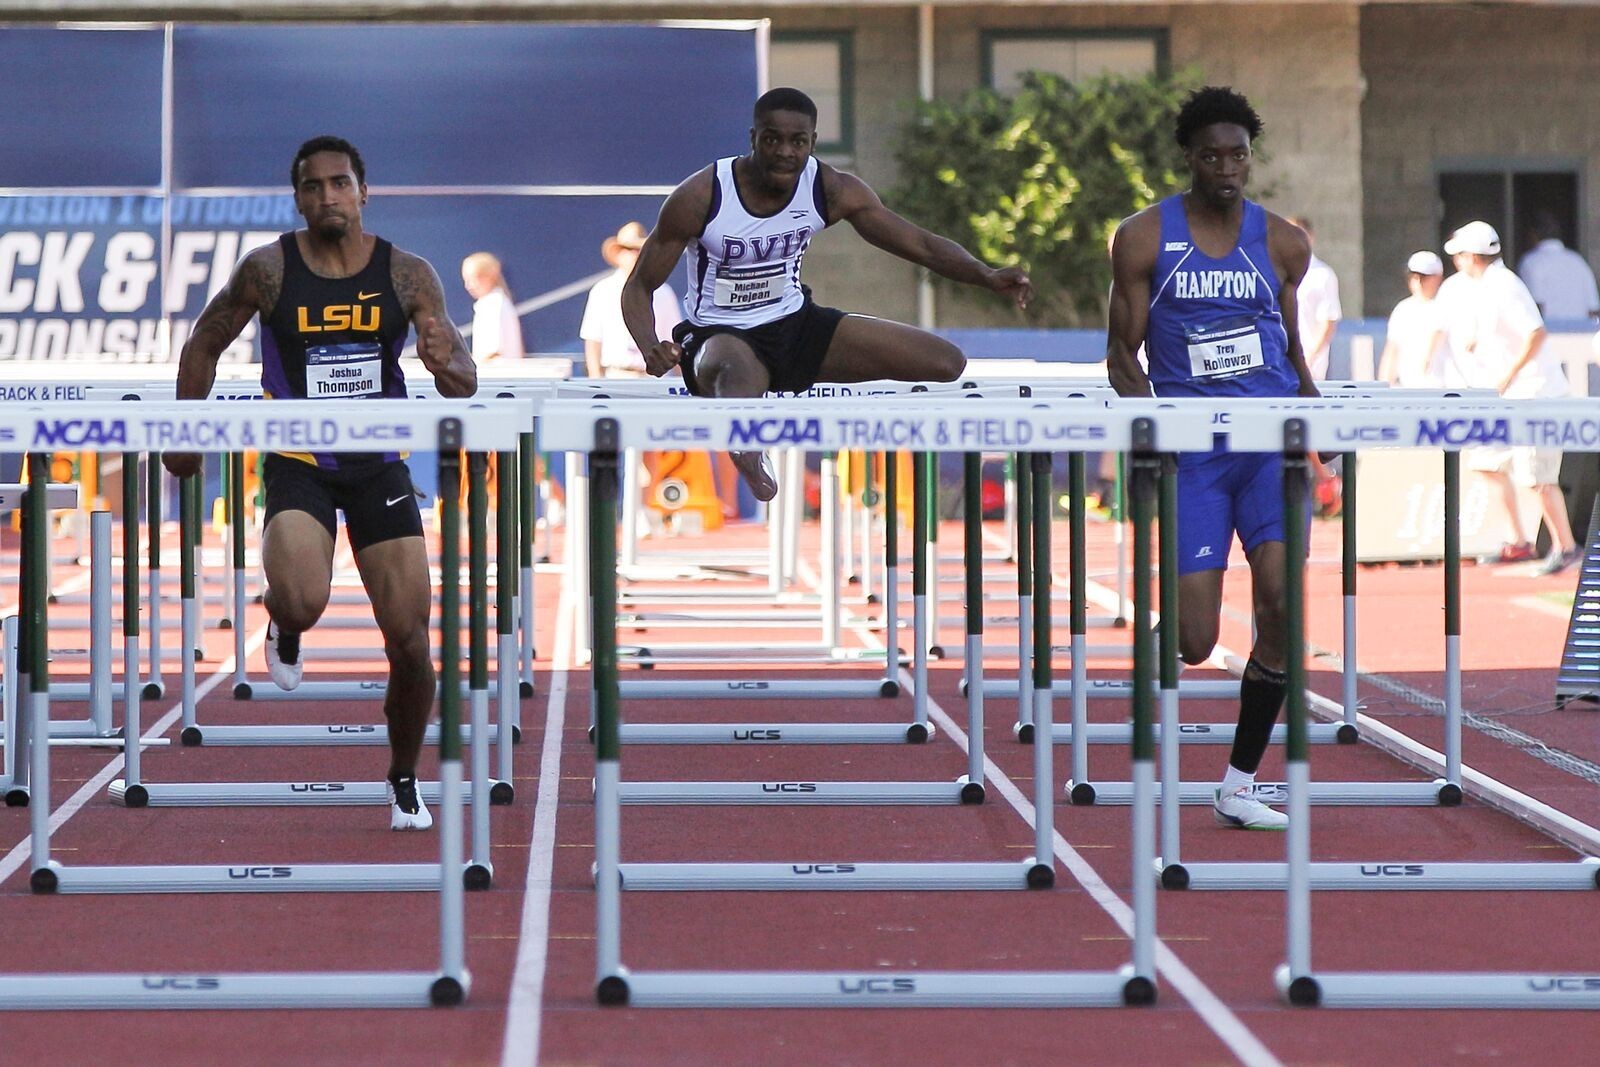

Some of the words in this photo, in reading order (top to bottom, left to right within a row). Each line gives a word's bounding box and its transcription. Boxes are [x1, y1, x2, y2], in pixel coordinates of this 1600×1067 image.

[98, 231, 158, 313] &
[734, 281, 769, 292] Michael
[1175, 271, 1258, 299] HAMPTON
[730, 291, 770, 304] Prejean
[298, 305, 381, 333] LSU
[1216, 344, 1235, 354] Trey
[1204, 354, 1251, 371] Holloway
[329, 368, 362, 378] Joshua
[316, 379, 373, 393] Thompson
[41, 387, 50, 400] &
[33, 419, 127, 446] NCAA
[142, 421, 231, 447] TRACK
[241, 421, 257, 446] &
[264, 420, 339, 447] FIELD
[349, 424, 412, 440] UCS
[648, 426, 711, 441] UCS
[728, 419, 822, 445] NCAA
[837, 419, 925, 445] TRACK
[935, 421, 949, 445] &
[960, 419, 1033, 445] FIELD
[1041, 425, 1106, 441] UCS
[1336, 427, 1399, 441] UCS
[1415, 419, 1510, 446] NCAA
[1525, 420, 1600, 447] TRAC
[328, 725, 375, 733] UCS
[734, 730, 781, 740] UCS
[1179, 725, 1211, 733] CS
[290, 783, 345, 792] UCS
[762, 783, 817, 793] UCS
[229, 867, 292, 878] UCS
[793, 864, 856, 875] UCS
[1361, 865, 1424, 876] UCS
[142, 976, 219, 990] UCS
[839, 978, 916, 994] UCS
[1531, 979, 1600, 992] UCS
